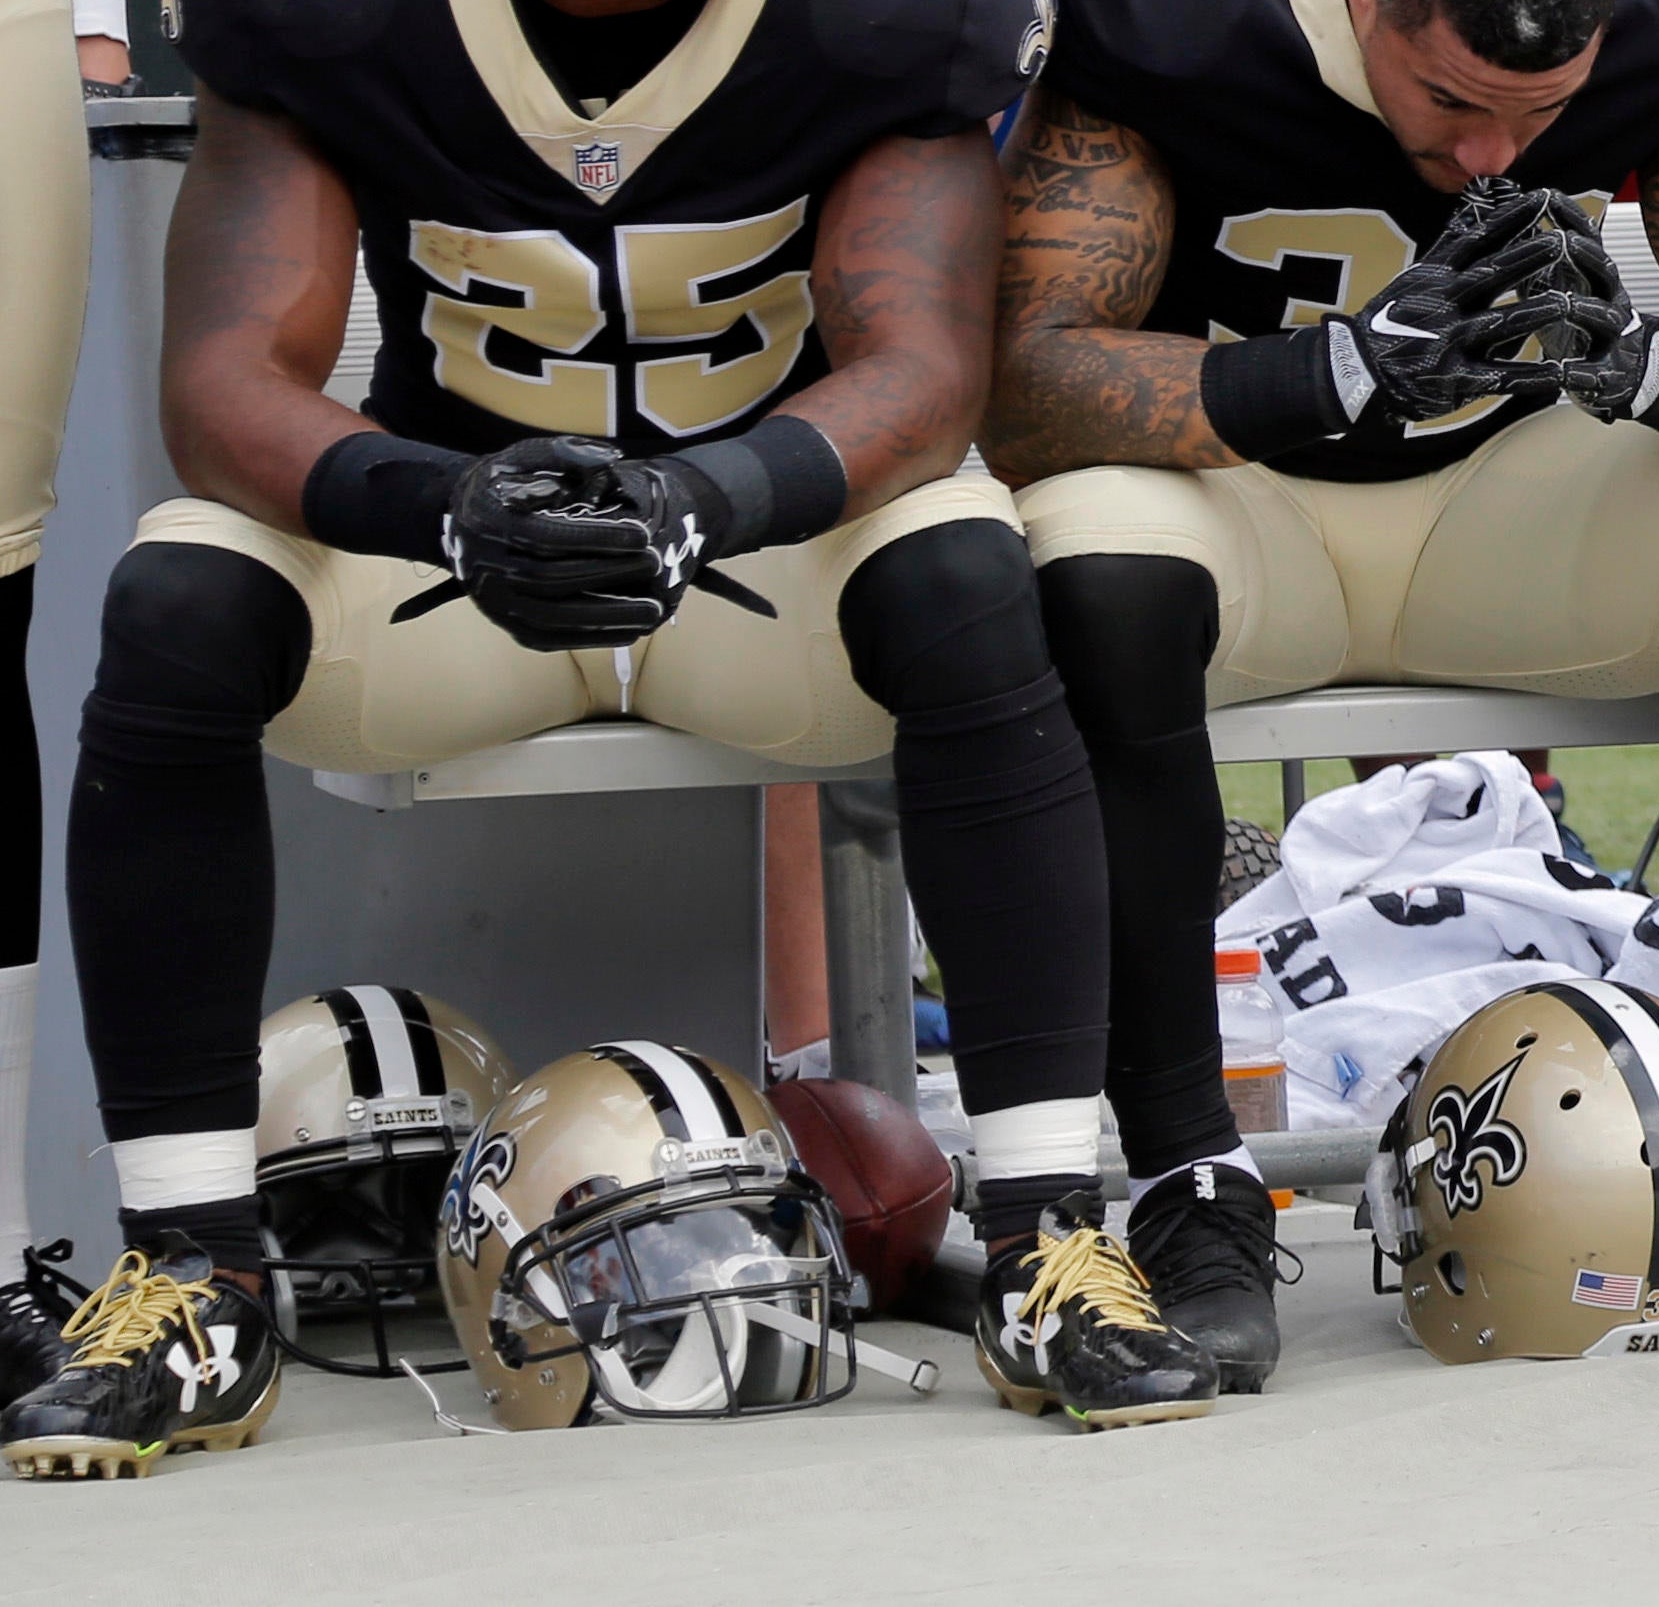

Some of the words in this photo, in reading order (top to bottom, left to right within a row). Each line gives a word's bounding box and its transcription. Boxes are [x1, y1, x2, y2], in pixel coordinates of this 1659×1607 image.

[580, 164, 616, 186] NFL
[408, 195, 816, 438] 25
[374, 1107, 439, 1126] SAINTS
[686, 1145, 741, 1163] SAINTS
[1193, 1164, 1216, 1200] VPR
